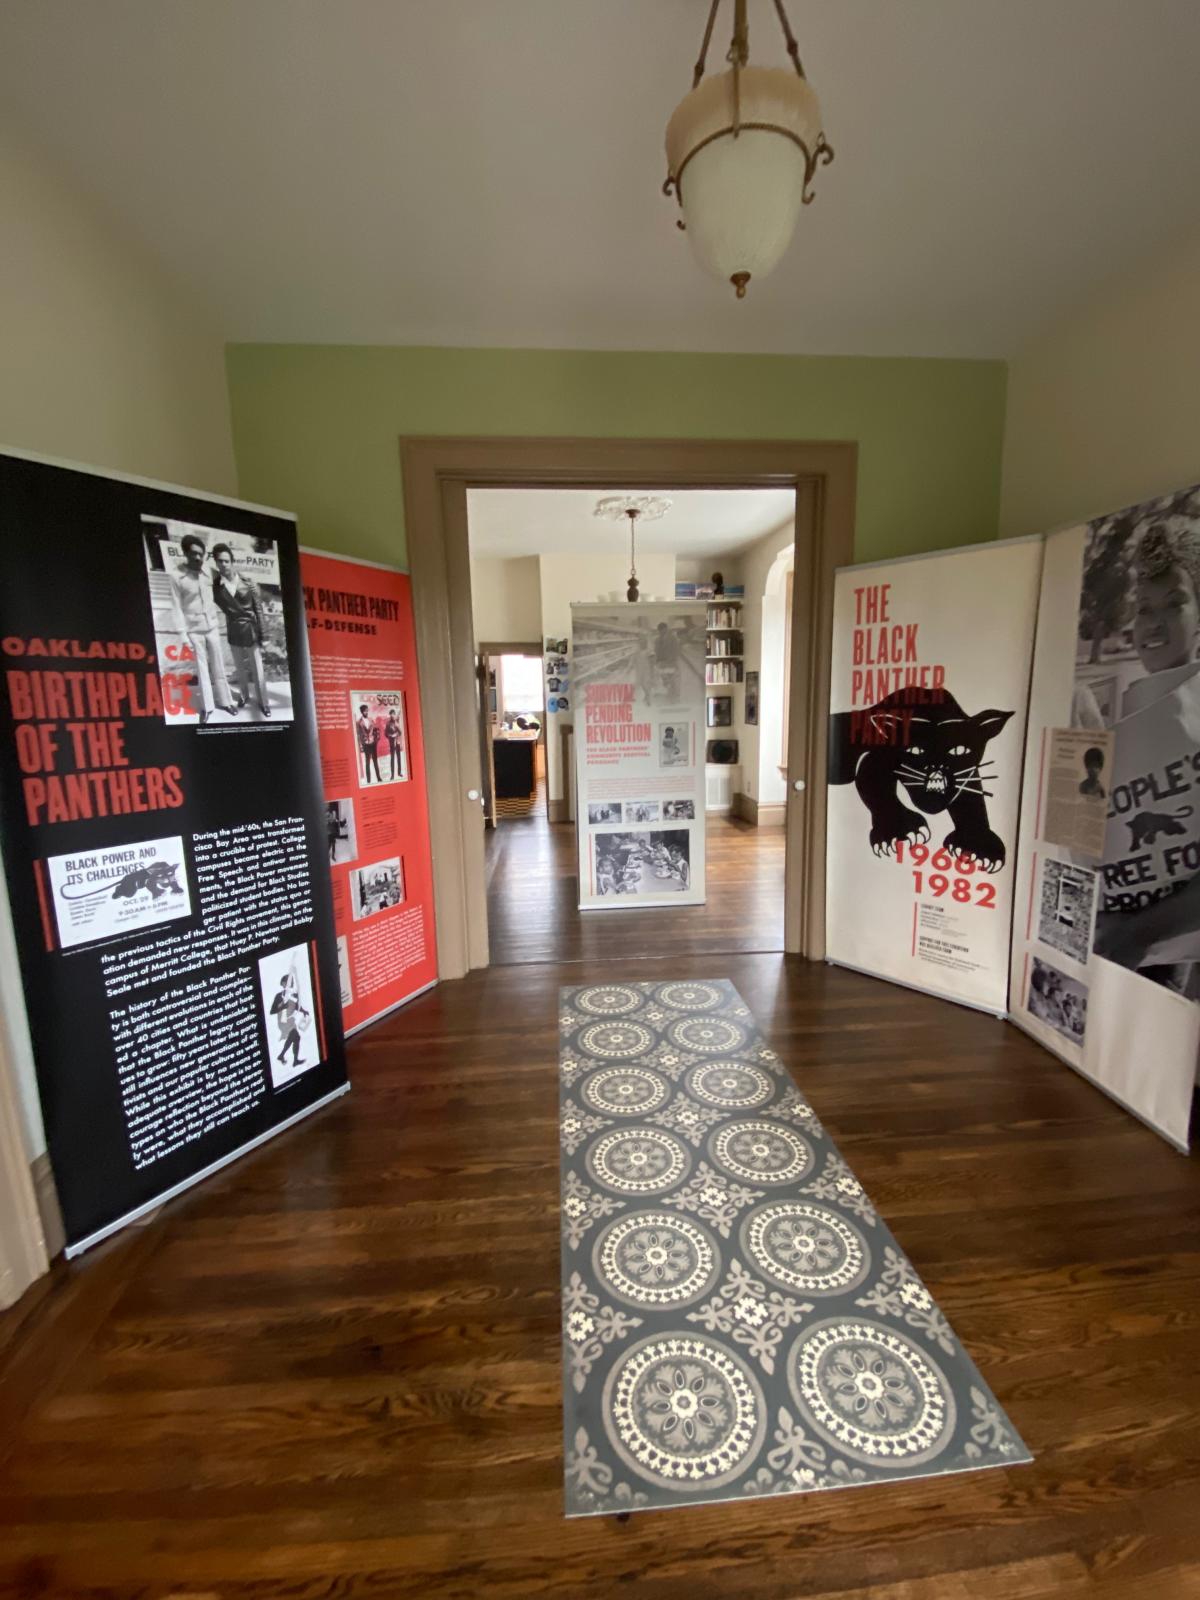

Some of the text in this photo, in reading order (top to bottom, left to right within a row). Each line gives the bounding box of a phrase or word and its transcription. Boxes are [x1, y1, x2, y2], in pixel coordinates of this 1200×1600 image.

[246, 556, 276, 569] PARTY
[318, 588, 368, 618] PANTHER
[369, 597, 400, 623] PARTY
[853, 584, 891, 625] THE
[1, 637, 195, 665] OAKLAND, CA
[852, 623, 919, 666] BLACK
[6, 670, 198, 720] BIRTHPLACE
[851, 664, 945, 706] PANTHER
[585, 704, 633, 723] PENDING
[849, 706, 915, 747] PARTY
[15, 721, 129, 774] OF THE
[586, 723, 652, 744] REVOLUTION
[22, 766, 184, 826] PANTHERS
[193, 832, 218, 841] During
[219, 846, 246, 857] crucible
[281, 836, 306, 844] College
[267, 825, 305, 837] transformed
[65, 846, 156, 872] BLACK POWER AND
[67, 862, 145, 886] ITS CHALLENGES
[197, 861, 232, 872] campuses
[234, 855, 259, 864] became
[262, 849, 284, 858] electric
[198, 875, 214, 883] Free
[218, 867, 243, 879] Speech
[247, 863, 259, 871] and
[263, 858, 286, 867] antiwar
[224, 879, 235, 887] the
[237, 874, 255, 884] Black
[256, 870, 275, 878] Power
[277, 862, 308, 873] movement
[1093, 853, 1157, 889] REE
[201, 893, 215, 903] and
[230, 883, 256, 896] demand
[269, 876, 285, 885] Black
[287, 872, 309, 880] Studies
[202, 898, 238, 916] politicized
[239, 892, 262, 903] student
[912, 870, 997, 909] 1982
[203, 916, 216, 926] ger
[218, 908, 241, 922] patient
[243, 903, 257, 912] with
[271, 896, 288, 904] status
[290, 892, 302, 900] quo
[101, 955, 116, 963] the
[118, 944, 154, 960] previous
[156, 936, 181, 947] tactics
[183, 931, 191, 940] of
[193, 929, 206, 937] the
[207, 923, 223, 933] Civil
[225, 918, 245, 928] Rights
[105, 971, 138, 986] campus
[140, 965, 149, 974] of
[151, 958, 178, 971] Merritt
[214, 943, 228, 952] that
[230, 938, 247, 947] Huey
[255, 927, 279, 938] Newton
[281, 921, 293, 930] and
[294, 916, 313, 925] Bobby
[103, 964, 126, 975] ation
[127, 948, 172, 967] demanded
[173, 945, 190, 953] new
[107, 984, 131, 997] Seale
[134, 978, 149, 988] met
[151, 971, 167, 982] and
[169, 960, 202, 976] founded
[203, 958, 215, 966] the
[217, 950, 236, 961] Black
[237, 943, 261, 954] Panther
[109, 1010, 126, 1019] The
[129, 999, 157, 1013] history
[171, 990, 184, 998] the
[186, 980, 207, 992] Black
[210, 971, 236, 984] Panther
[111, 1023, 120, 1031] ty
[130, 1011, 150, 1023] both
[152, 992, 201, 1015] controversial
[203, 986, 218, 997] and
[113, 1030, 132, 1041] with
[133, 1016, 167, 1034] different
[169, 1003, 207, 1020] evolutions
[217, 992, 234, 1003] each
[115, 1018, 188, 1052] over 40 cities and
